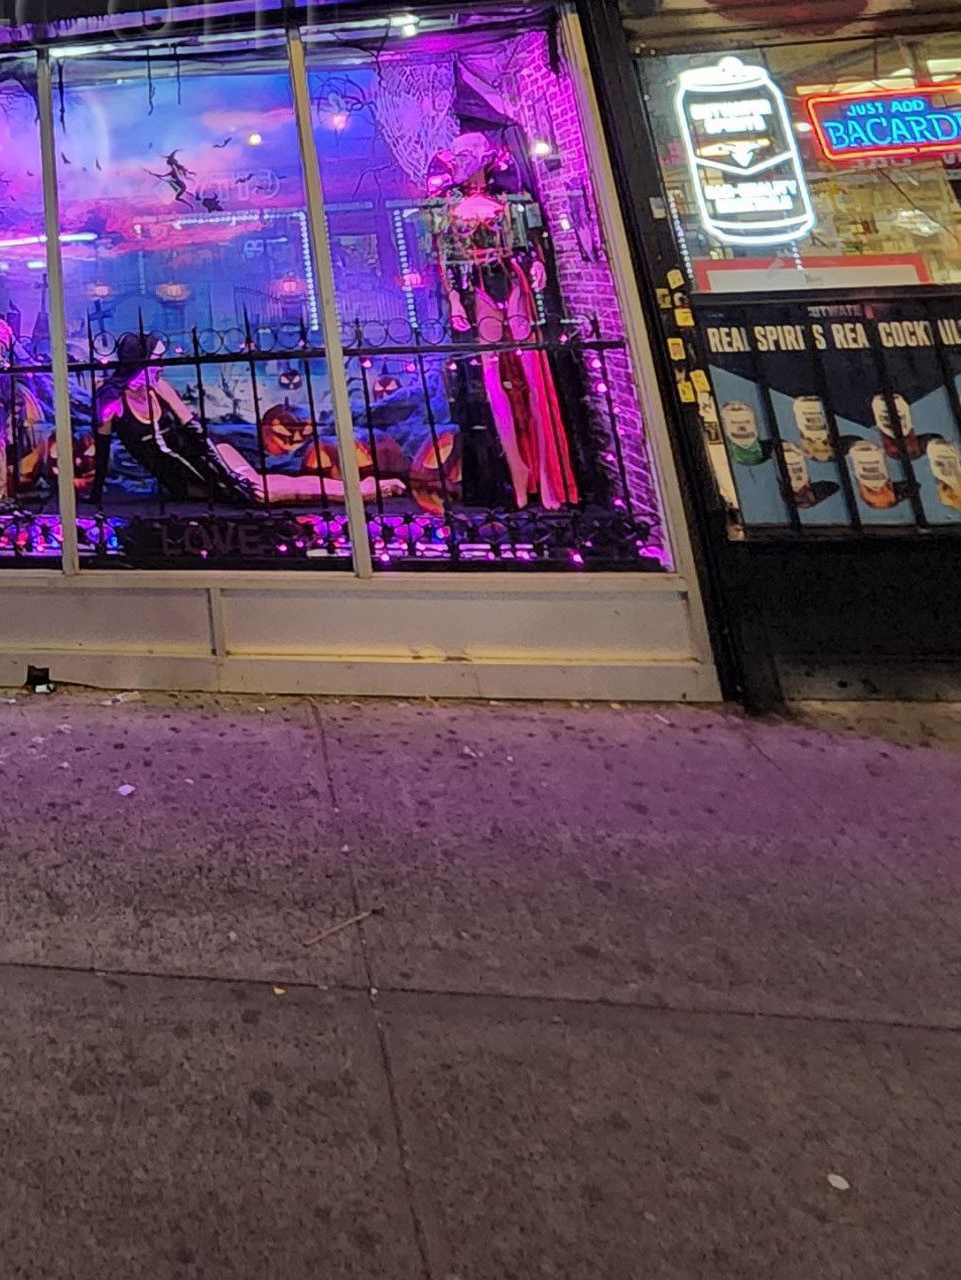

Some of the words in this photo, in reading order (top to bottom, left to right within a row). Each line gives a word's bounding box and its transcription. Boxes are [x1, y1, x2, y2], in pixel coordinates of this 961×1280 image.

[846, 101, 884, 116] JUST
[890, 98, 925, 113] ADD
[754, 324, 827, 351] SPIRIS
[831, 322, 871, 349] REA
[160, 524, 263, 556] LOVE
